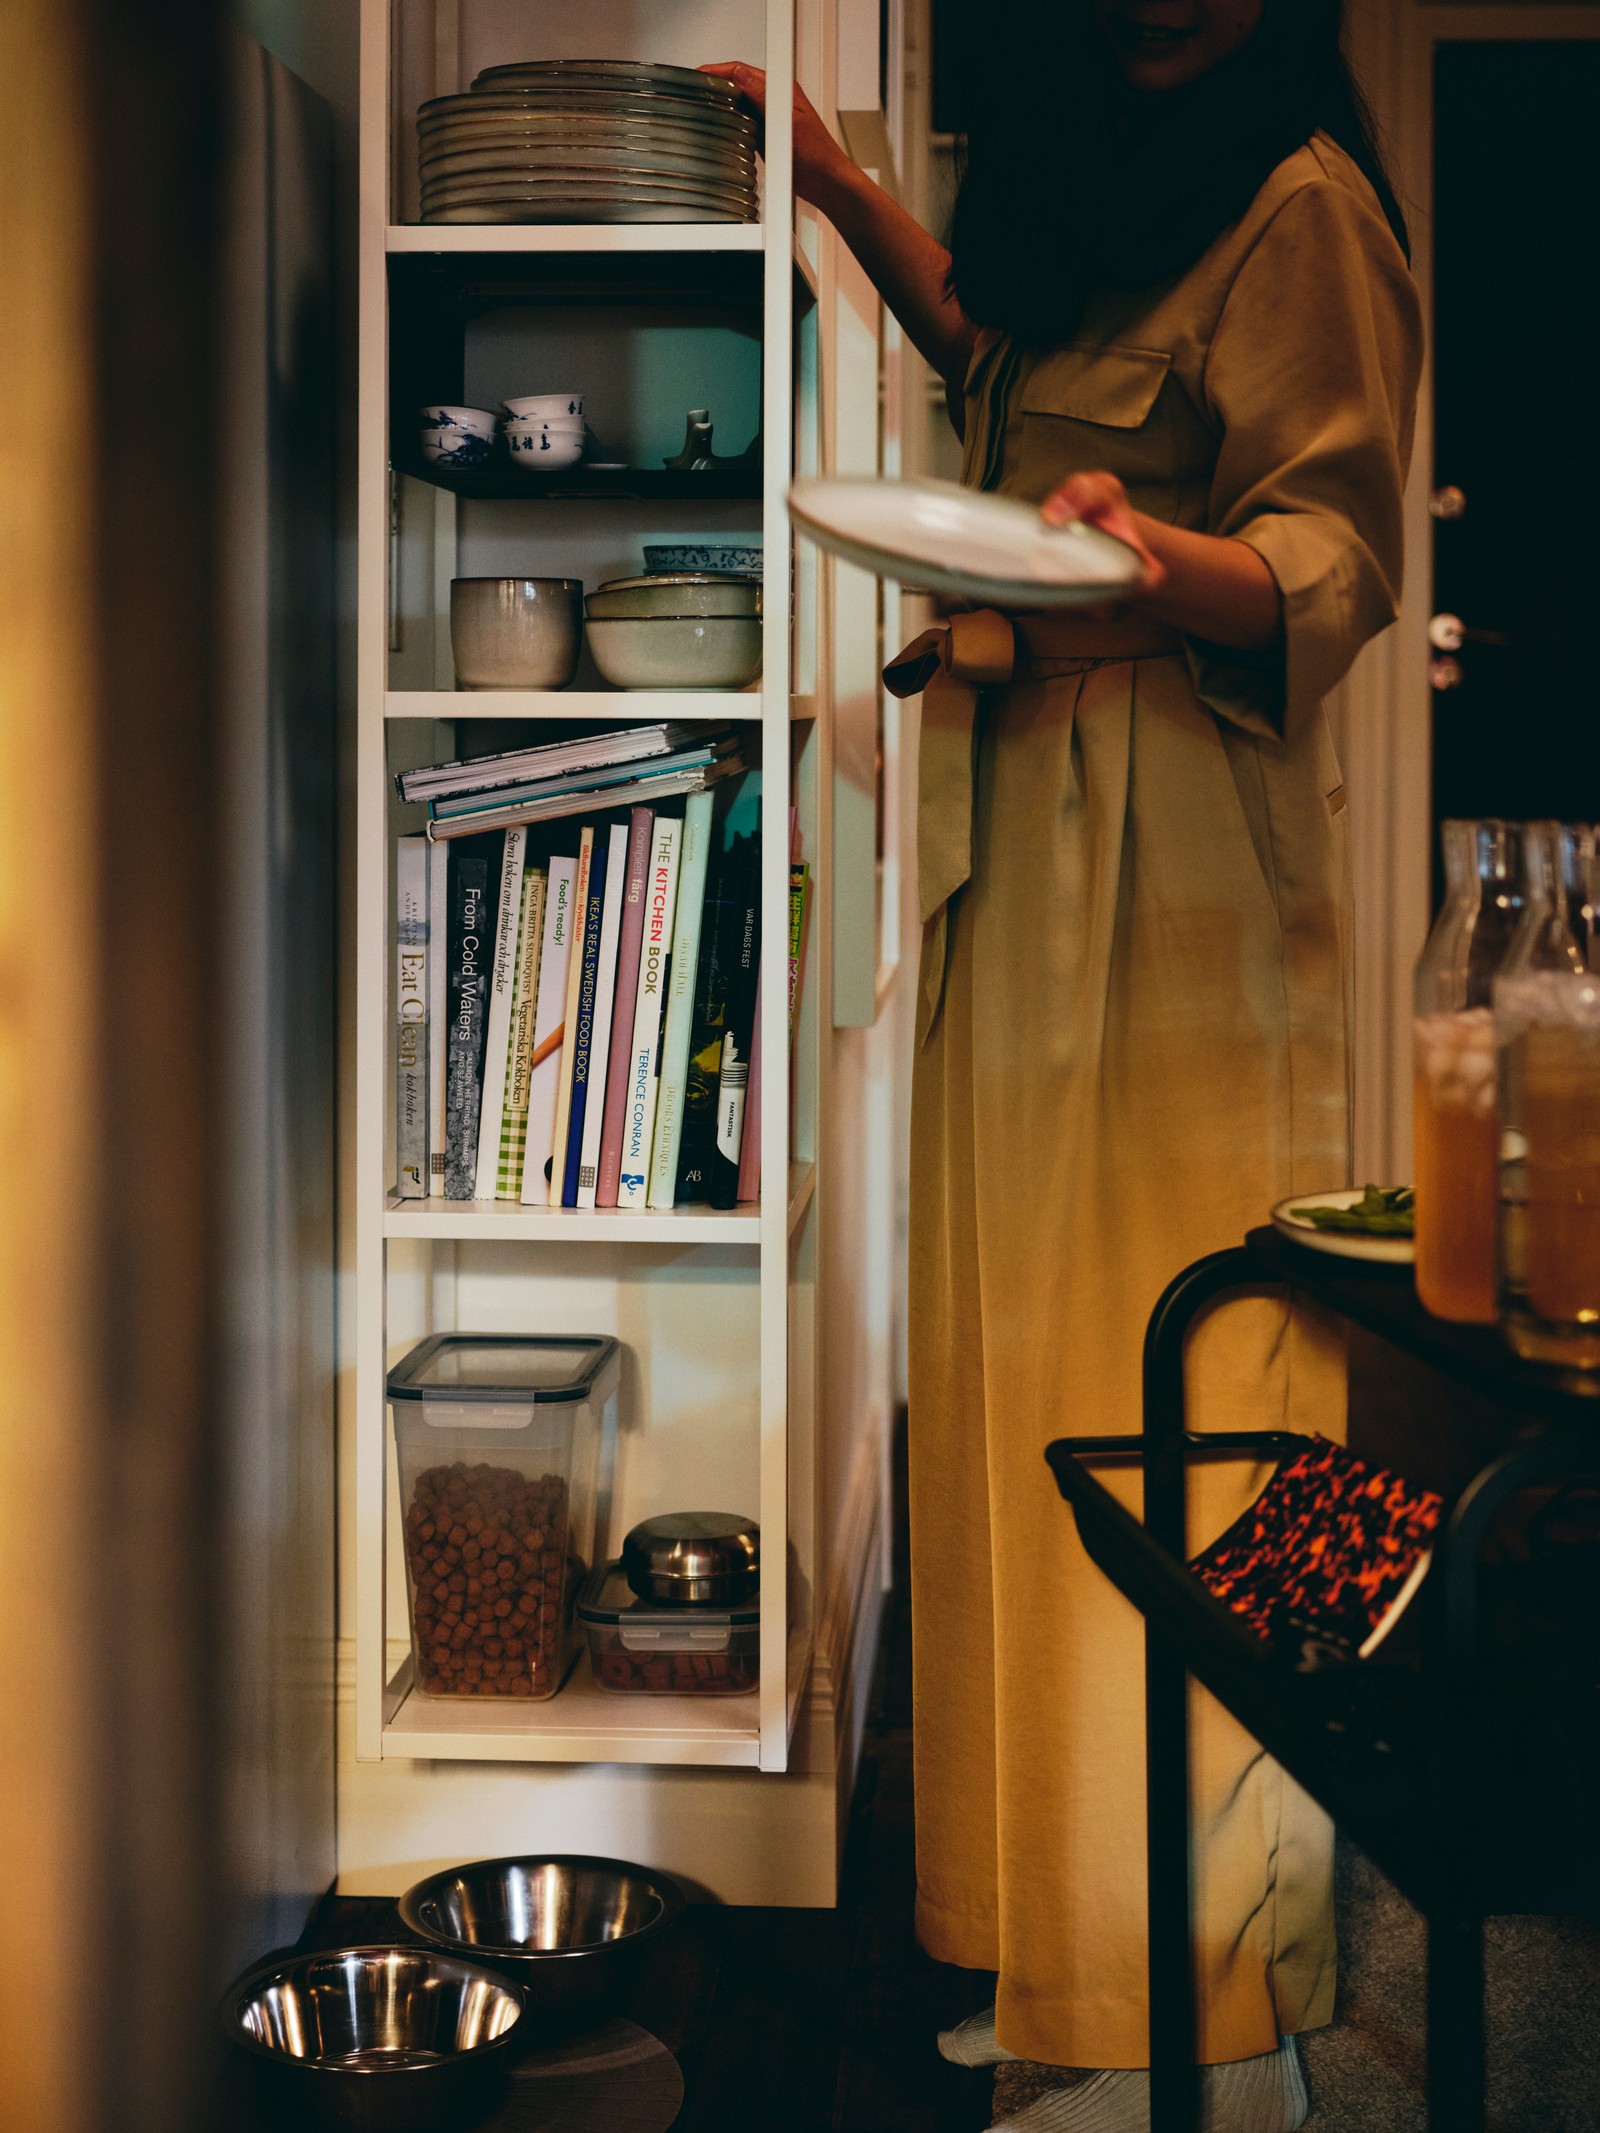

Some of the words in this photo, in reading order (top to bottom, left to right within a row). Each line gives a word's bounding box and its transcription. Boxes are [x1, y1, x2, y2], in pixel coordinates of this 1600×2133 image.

[506, 831, 520, 858] Stora
[632, 826, 648, 875] Komplett
[657, 833, 673, 863] THE
[504, 858, 519, 889] boken
[579, 844, 590, 893] Bildhandboken
[464, 888, 481, 930] From
[503, 889, 513, 908] om
[628, 878, 643, 904] färg
[649, 867, 669, 942] KITCHEN
[500, 908, 514, 943] drinkar
[553, 912, 566, 946] ready!
[575, 904, 585, 942] Kryddväxter
[588, 897, 600, 931] IKEA'S
[462, 935, 479, 976] Cold
[499, 942, 511, 960] och
[585, 933, 598, 959] REAL
[743, 925, 753, 948] DAGS
[401, 953, 425, 992] Eat
[495, 960, 510, 995] drycker
[522, 941, 534, 995] SUNDQVIST
[644, 946, 661, 994] BOOK
[741, 949, 751, 969] FEST
[581, 962, 596, 1012] SWEDISH
[459, 981, 477, 1041] Waters
[516, 999, 532, 1053] Vegetariska
[401, 998, 425, 1068] Clean
[578, 1014, 591, 1048] FOOD
[457, 1050, 465, 1068] AND
[575, 1050, 588, 1083] BOOK
[635, 1048, 650, 1101] TERENCE
[455, 1069, 464, 1109] SEAWEED
[512, 1055, 527, 1104] Kokboken
[406, 1073, 418, 1126] kokboken
[630, 1102, 645, 1157] CONRAN
[726, 1101, 735, 1138] FANTASTISK
[461, 1129, 470, 1167] SHRIMPS
